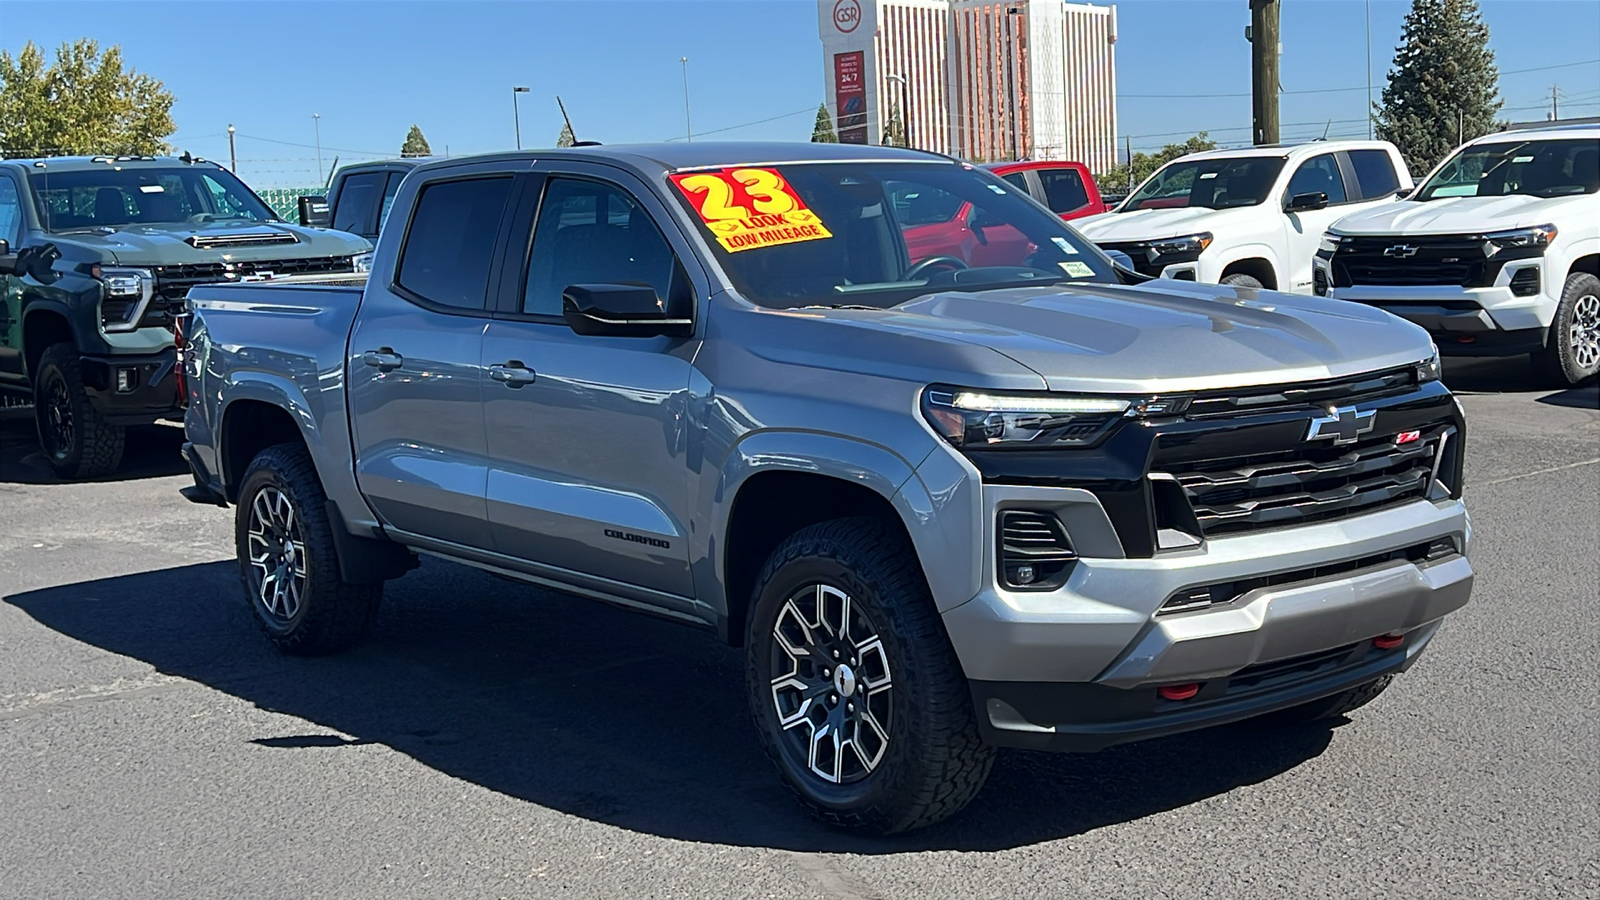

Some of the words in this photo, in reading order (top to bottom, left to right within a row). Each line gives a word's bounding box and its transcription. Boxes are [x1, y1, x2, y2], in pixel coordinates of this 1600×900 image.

[837, 6, 857, 22] GSR
[841, 73, 858, 83] 24/7
[680, 169, 798, 220] 23
[739, 213, 790, 230] LOOK
[725, 232, 762, 249] LOW
[759, 224, 821, 243] MILEAGE
[604, 528, 671, 549] COLORADO
